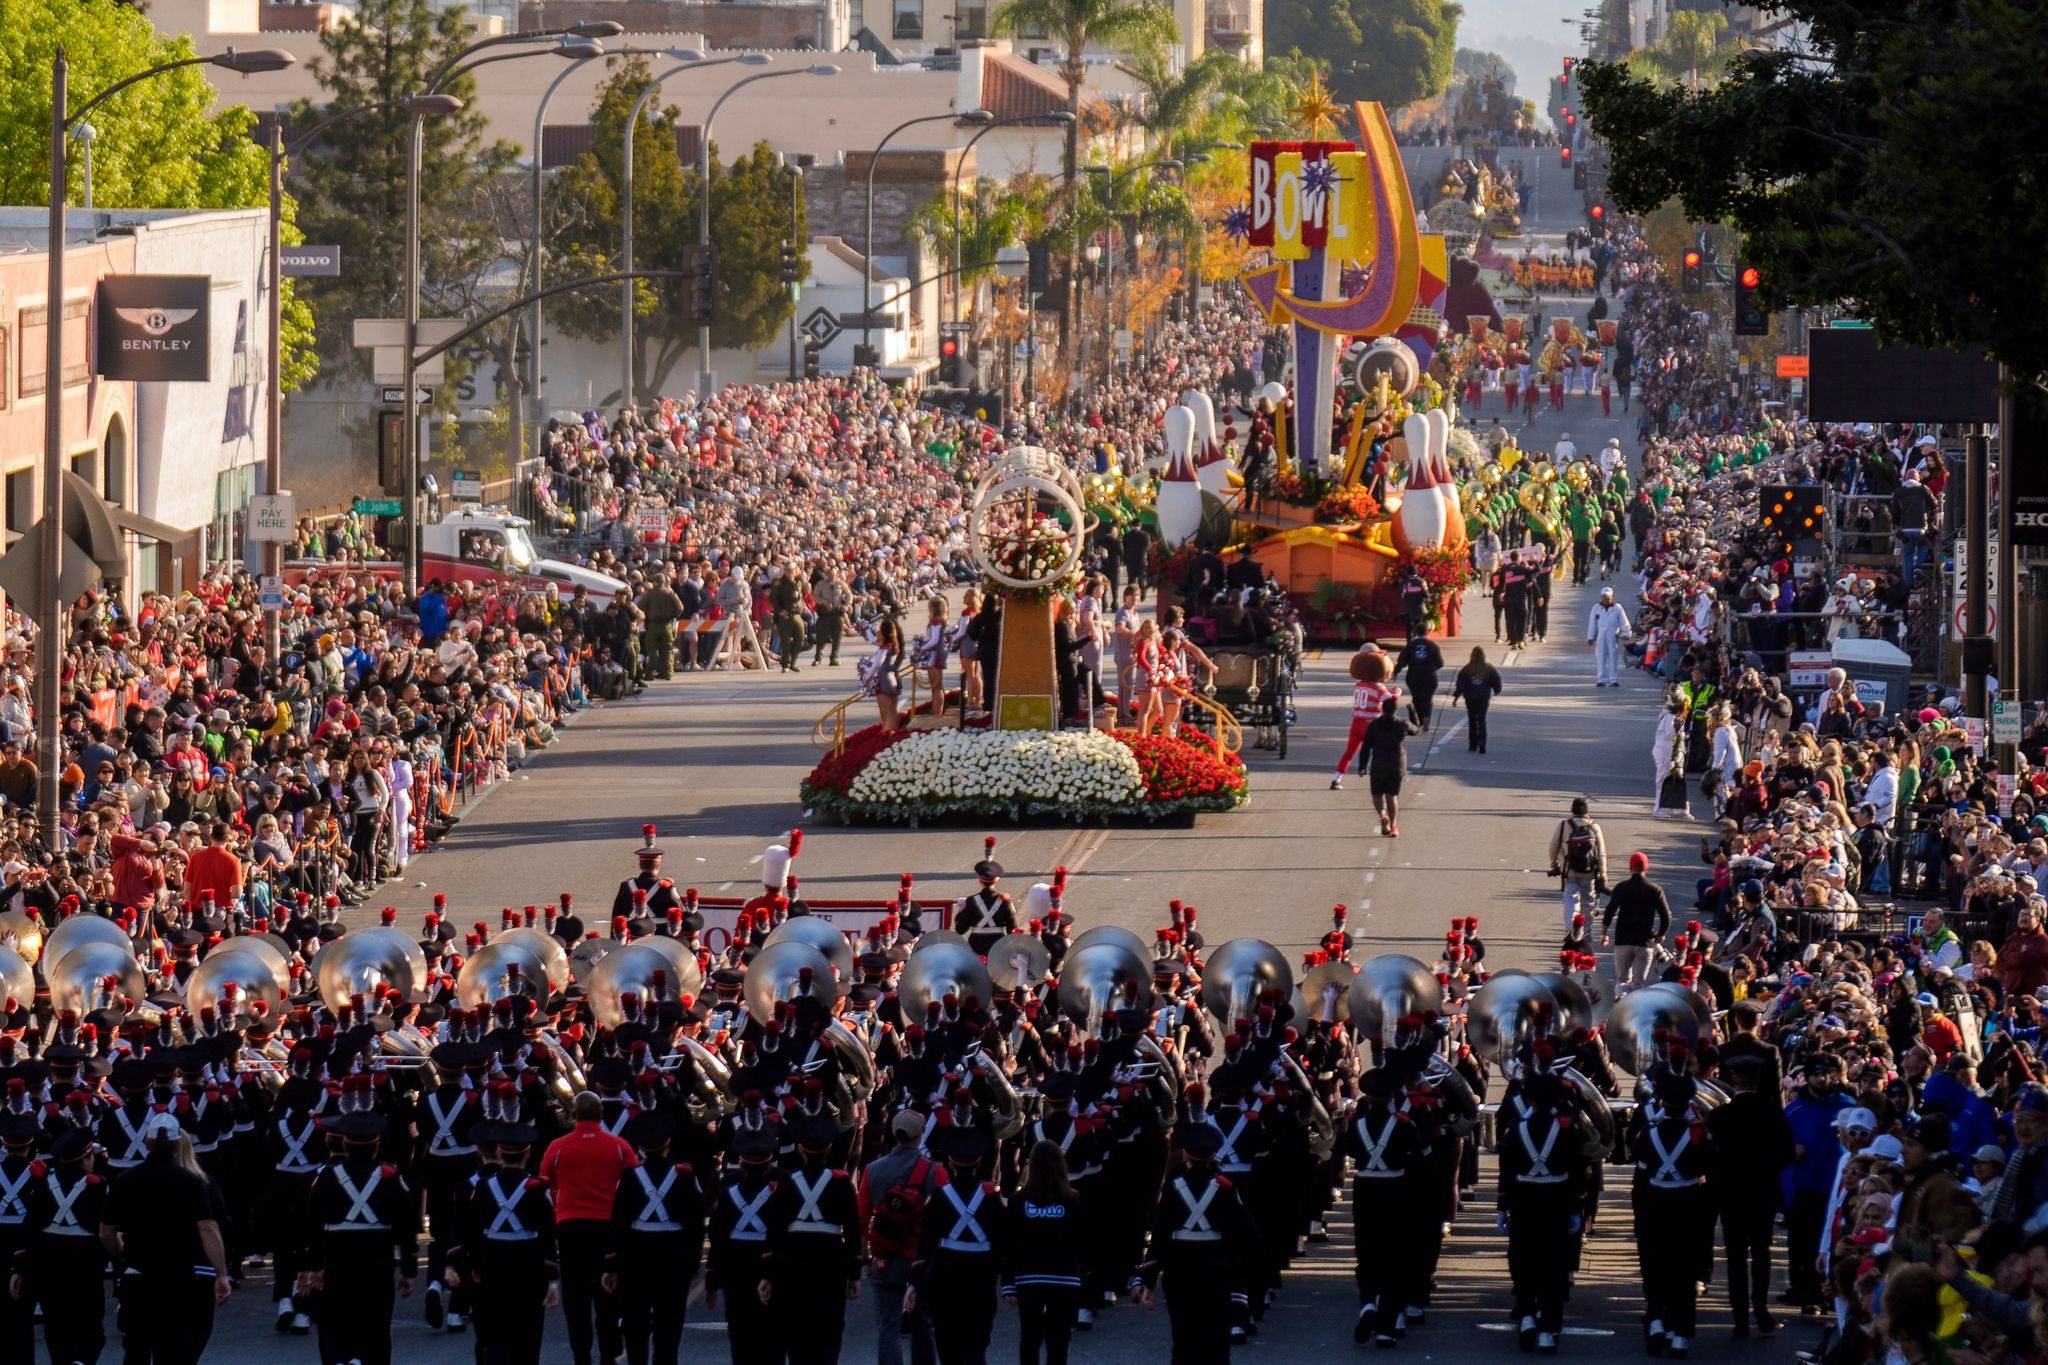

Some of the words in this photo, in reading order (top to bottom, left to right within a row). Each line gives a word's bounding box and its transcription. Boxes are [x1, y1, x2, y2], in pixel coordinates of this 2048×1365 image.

[1254, 156, 1349, 241] BOWL
[281, 256, 331, 265] VOLVO
[122, 339, 192, 350] BENTLEY
[357, 501, 366, 512] St
[369, 501, 389, 512] John
[261, 509, 282, 518] PAY
[257, 519, 286, 528] HERE
[640, 514, 662, 525] 235
[1857, 686, 1886, 695] United
